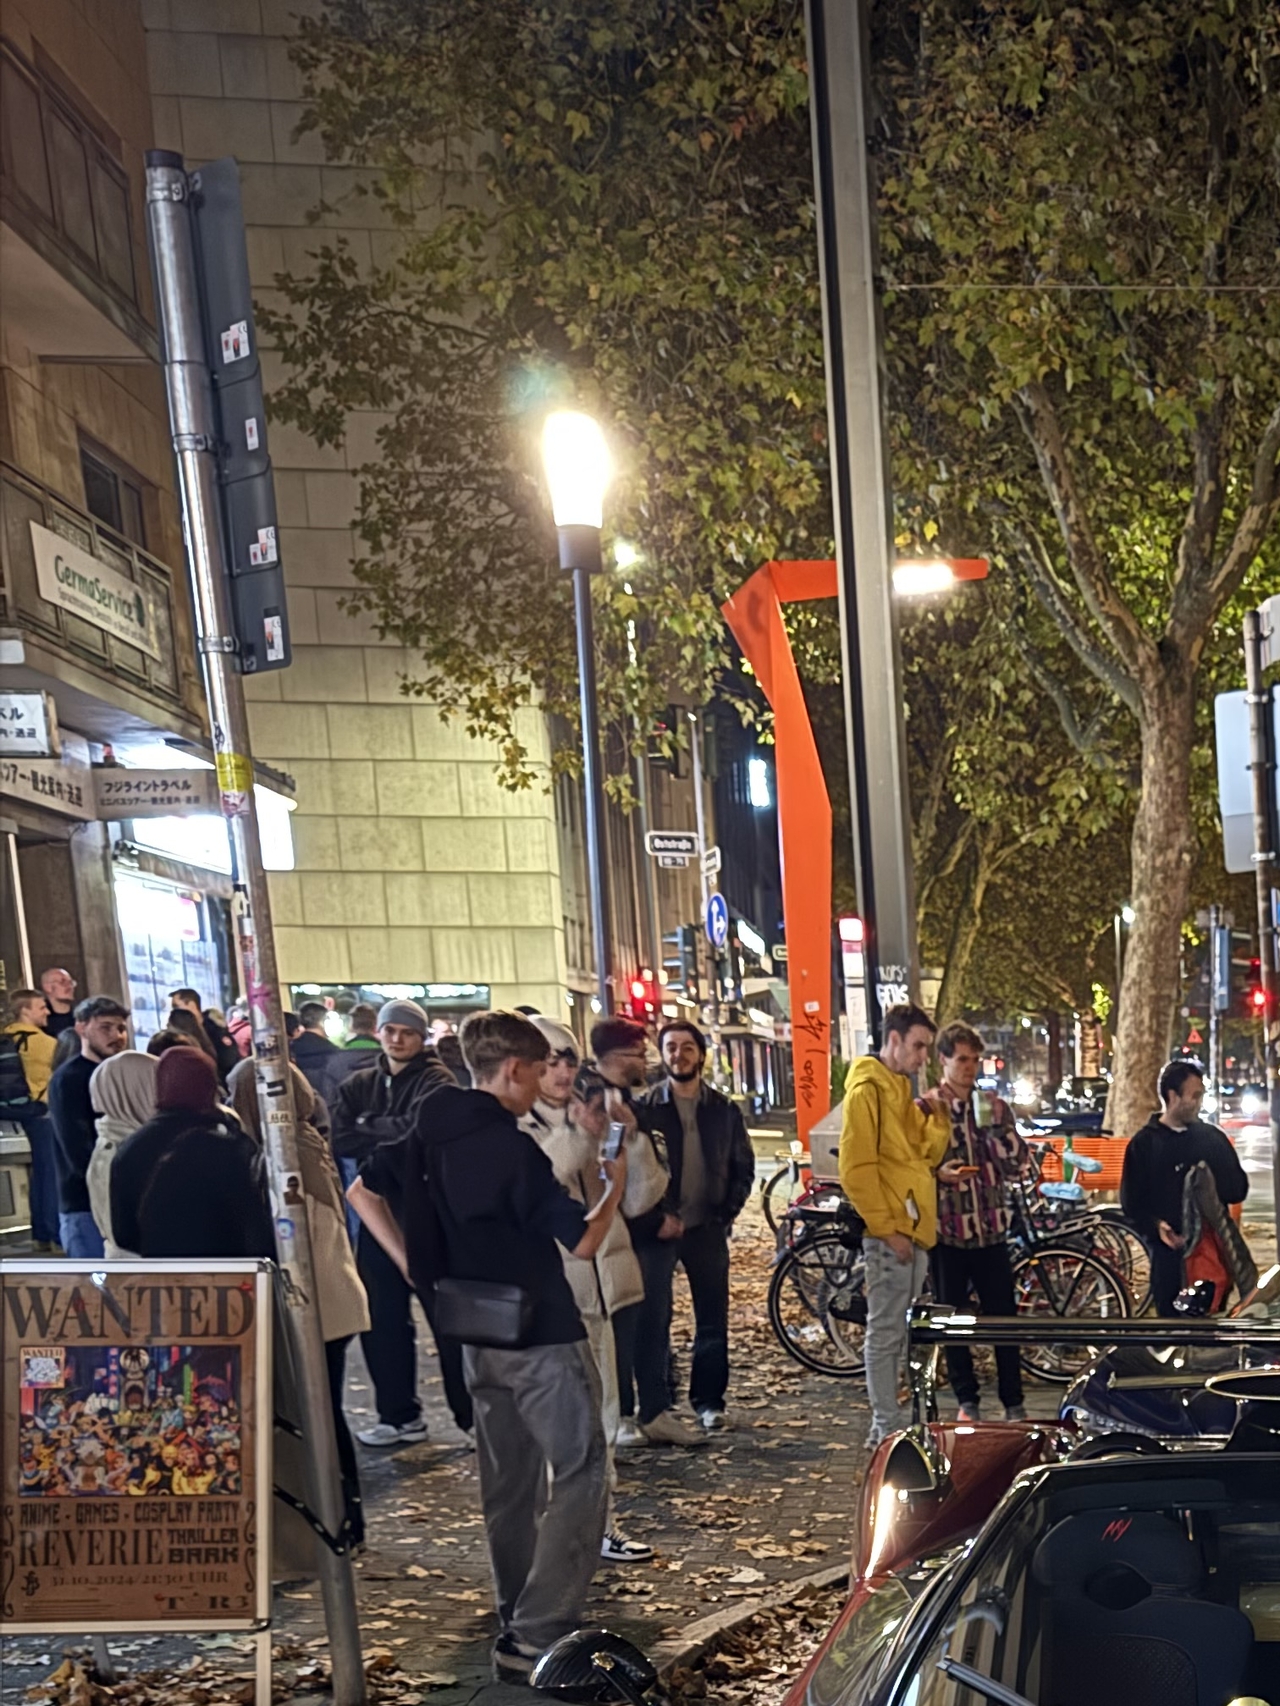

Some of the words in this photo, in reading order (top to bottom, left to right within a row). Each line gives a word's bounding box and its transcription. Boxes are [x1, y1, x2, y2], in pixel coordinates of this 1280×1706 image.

[54, 555, 134, 623] GermaService
[4, 1285, 254, 1339] WANTED
[21, 1503, 60, 1525] ANIME
[76, 1502, 119, 1524] GAMES
[134, 1501, 192, 1523] COSPLAY
[198, 1501, 239, 1522] PARTY
[19, 1529, 162, 1567] REVERIE
[168, 1528, 238, 1545] THRILLER
[169, 1547, 238, 1564] BARK
